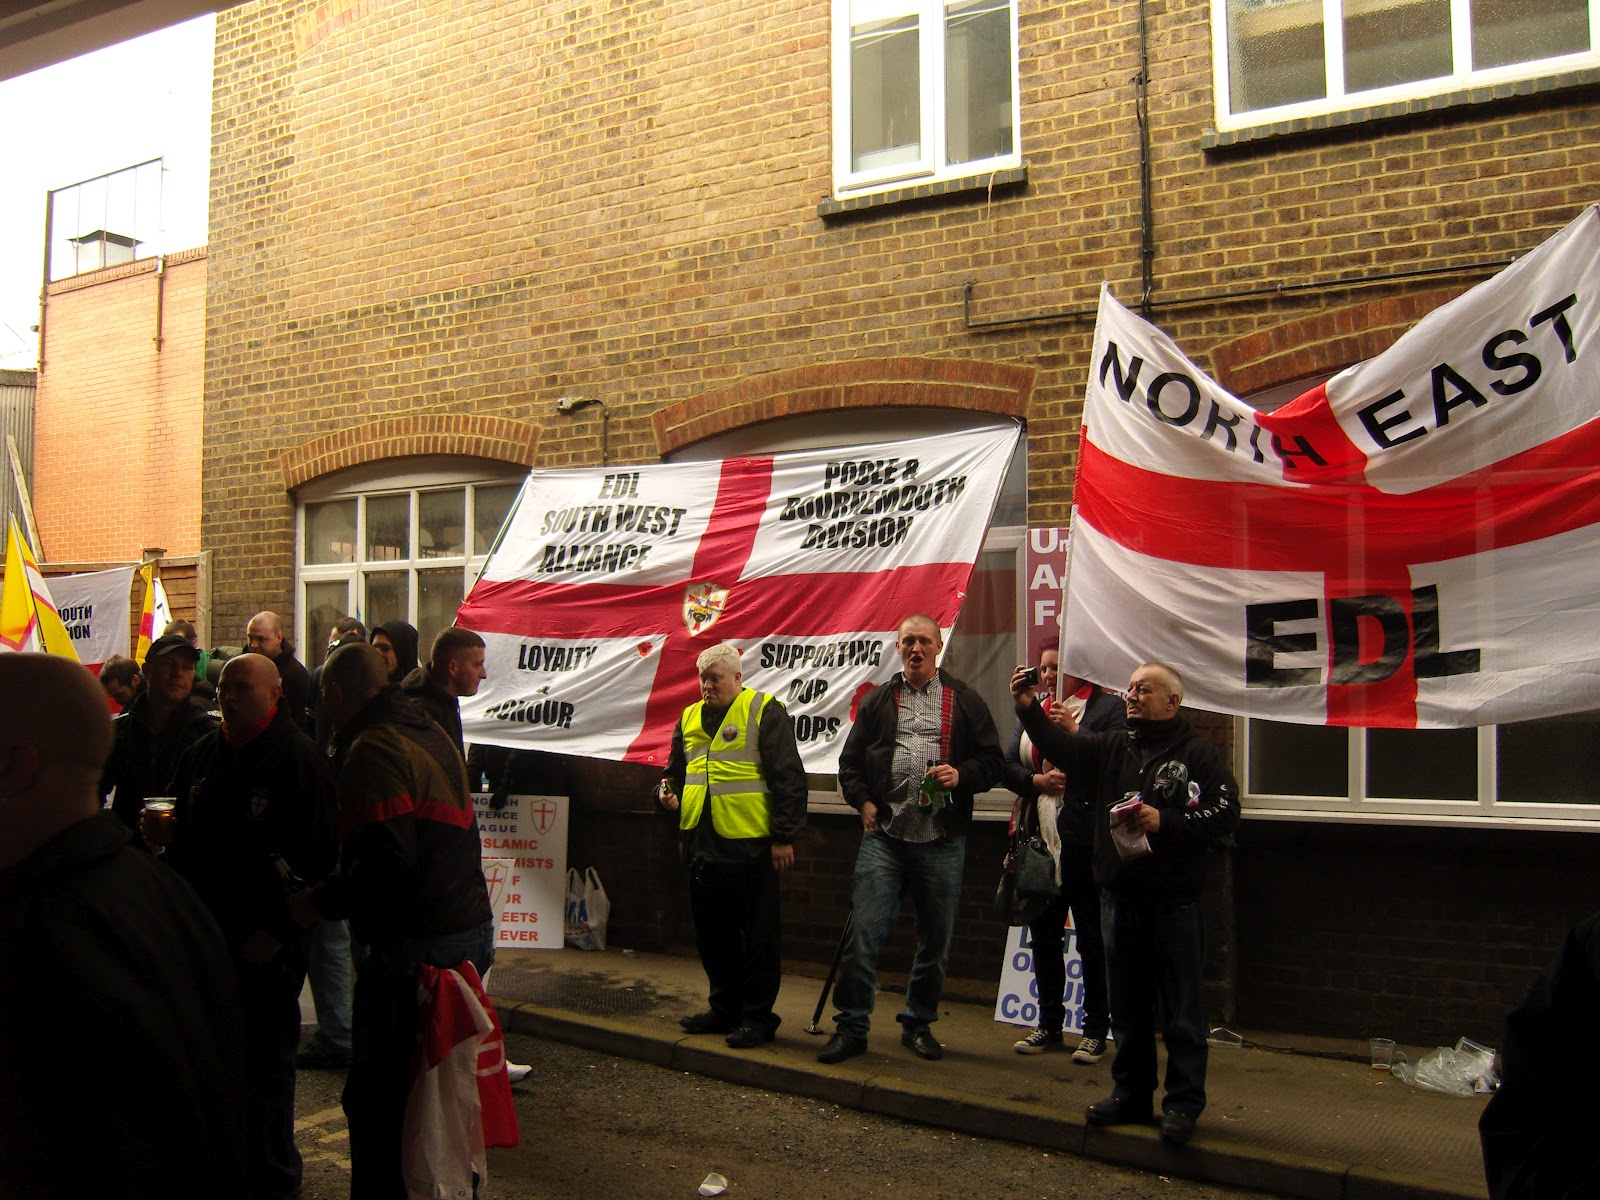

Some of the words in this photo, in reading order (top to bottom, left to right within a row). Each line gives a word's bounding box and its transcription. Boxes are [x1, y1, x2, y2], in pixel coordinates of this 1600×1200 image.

[1356, 293, 1578, 450] EAST
[598, 472, 640, 500] EDL
[824, 458, 900, 490] POOLE
[902, 458, 920, 482] &
[779, 475, 967, 521] BOURNEMOUTH
[540, 505, 613, 537] SOUTH
[615, 504, 688, 537] WEST
[800, 516, 914, 549] DIVISION
[537, 544, 653, 573] ALLIANCE
[1245, 583, 1481, 689] EDL
[517, 644, 598, 672] LOYALTY
[760, 640, 884, 669] SUPPORTING
